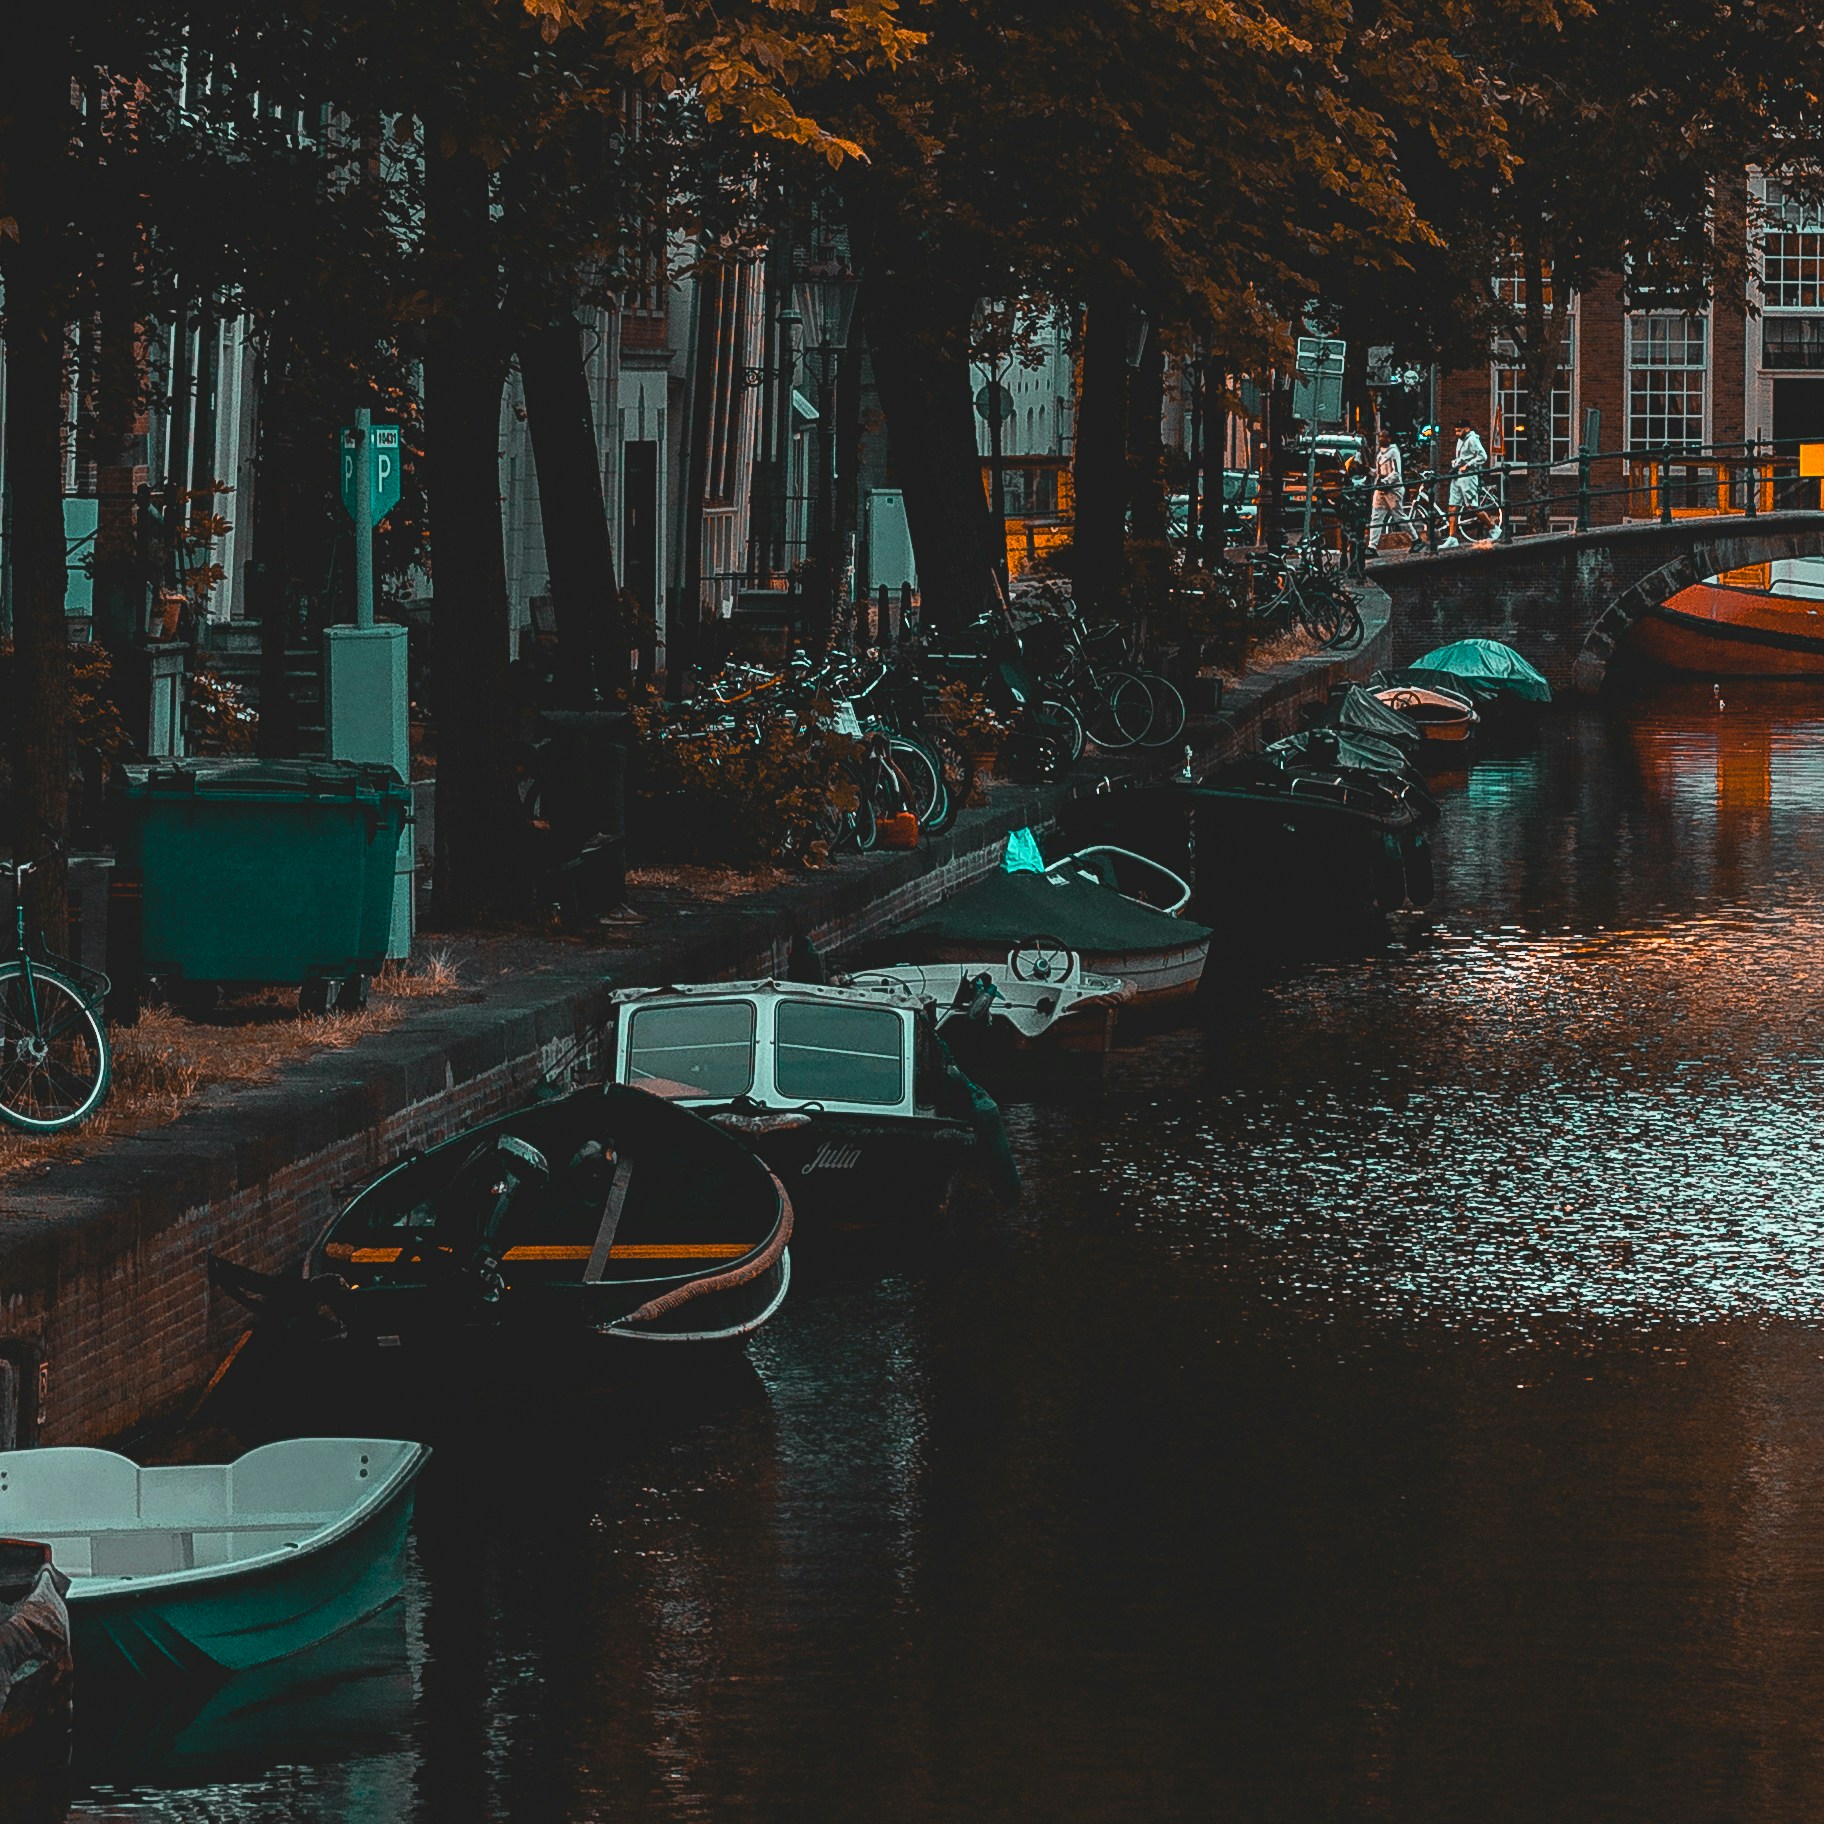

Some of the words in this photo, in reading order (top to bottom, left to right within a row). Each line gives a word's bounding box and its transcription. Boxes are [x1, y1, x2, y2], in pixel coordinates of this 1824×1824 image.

[345, 455, 353, 493] P
[378, 454, 391, 493] P
[801, 1140, 862, 1175] Julia
